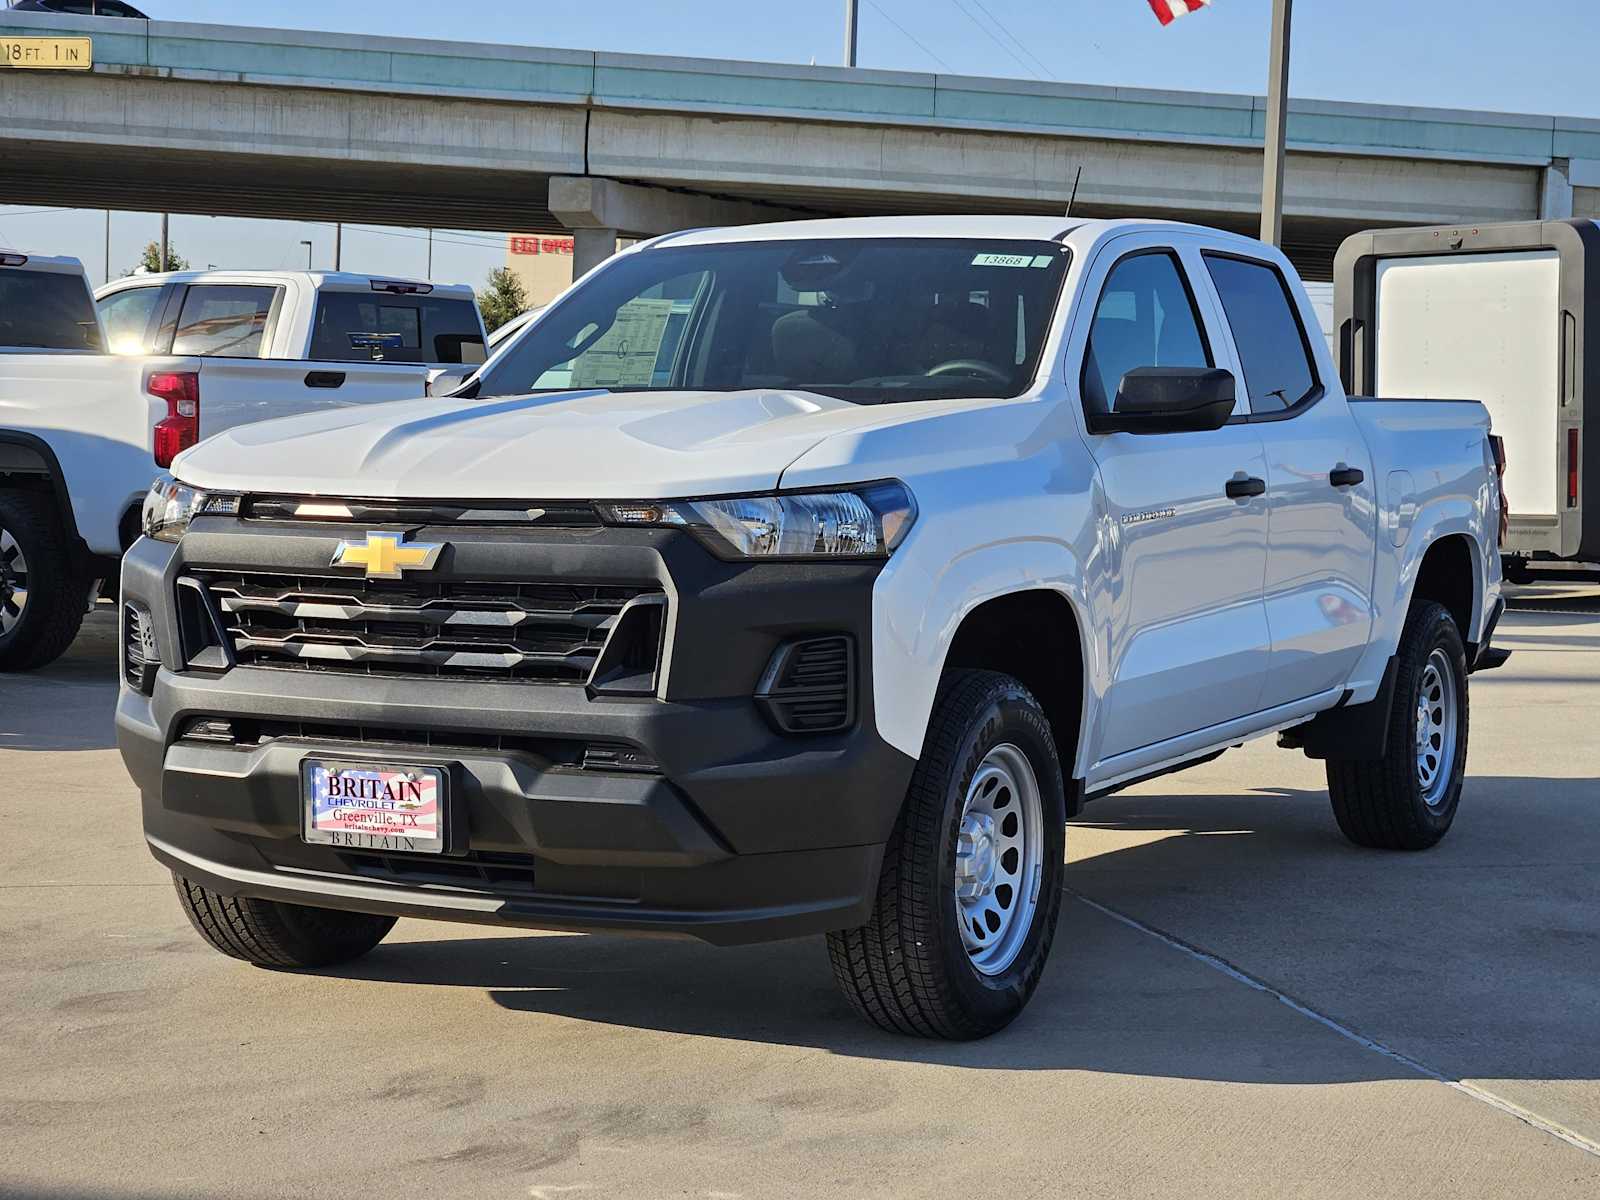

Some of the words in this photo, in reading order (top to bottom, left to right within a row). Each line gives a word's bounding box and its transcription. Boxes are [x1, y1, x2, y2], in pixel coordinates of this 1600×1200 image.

[6, 44, 21, 61] 18
[54, 44, 59, 61] 1
[65, 48, 79, 61] IN
[983, 255, 1023, 265] 13868
[327, 776, 422, 801] BRITAIN
[327, 797, 396, 810] CHEVROLET
[333, 809, 397, 826] Greenville,
[400, 814, 419, 827] TX
[344, 823, 405, 834] britainchevy.com
[331, 831, 417, 850] BRITAIN
